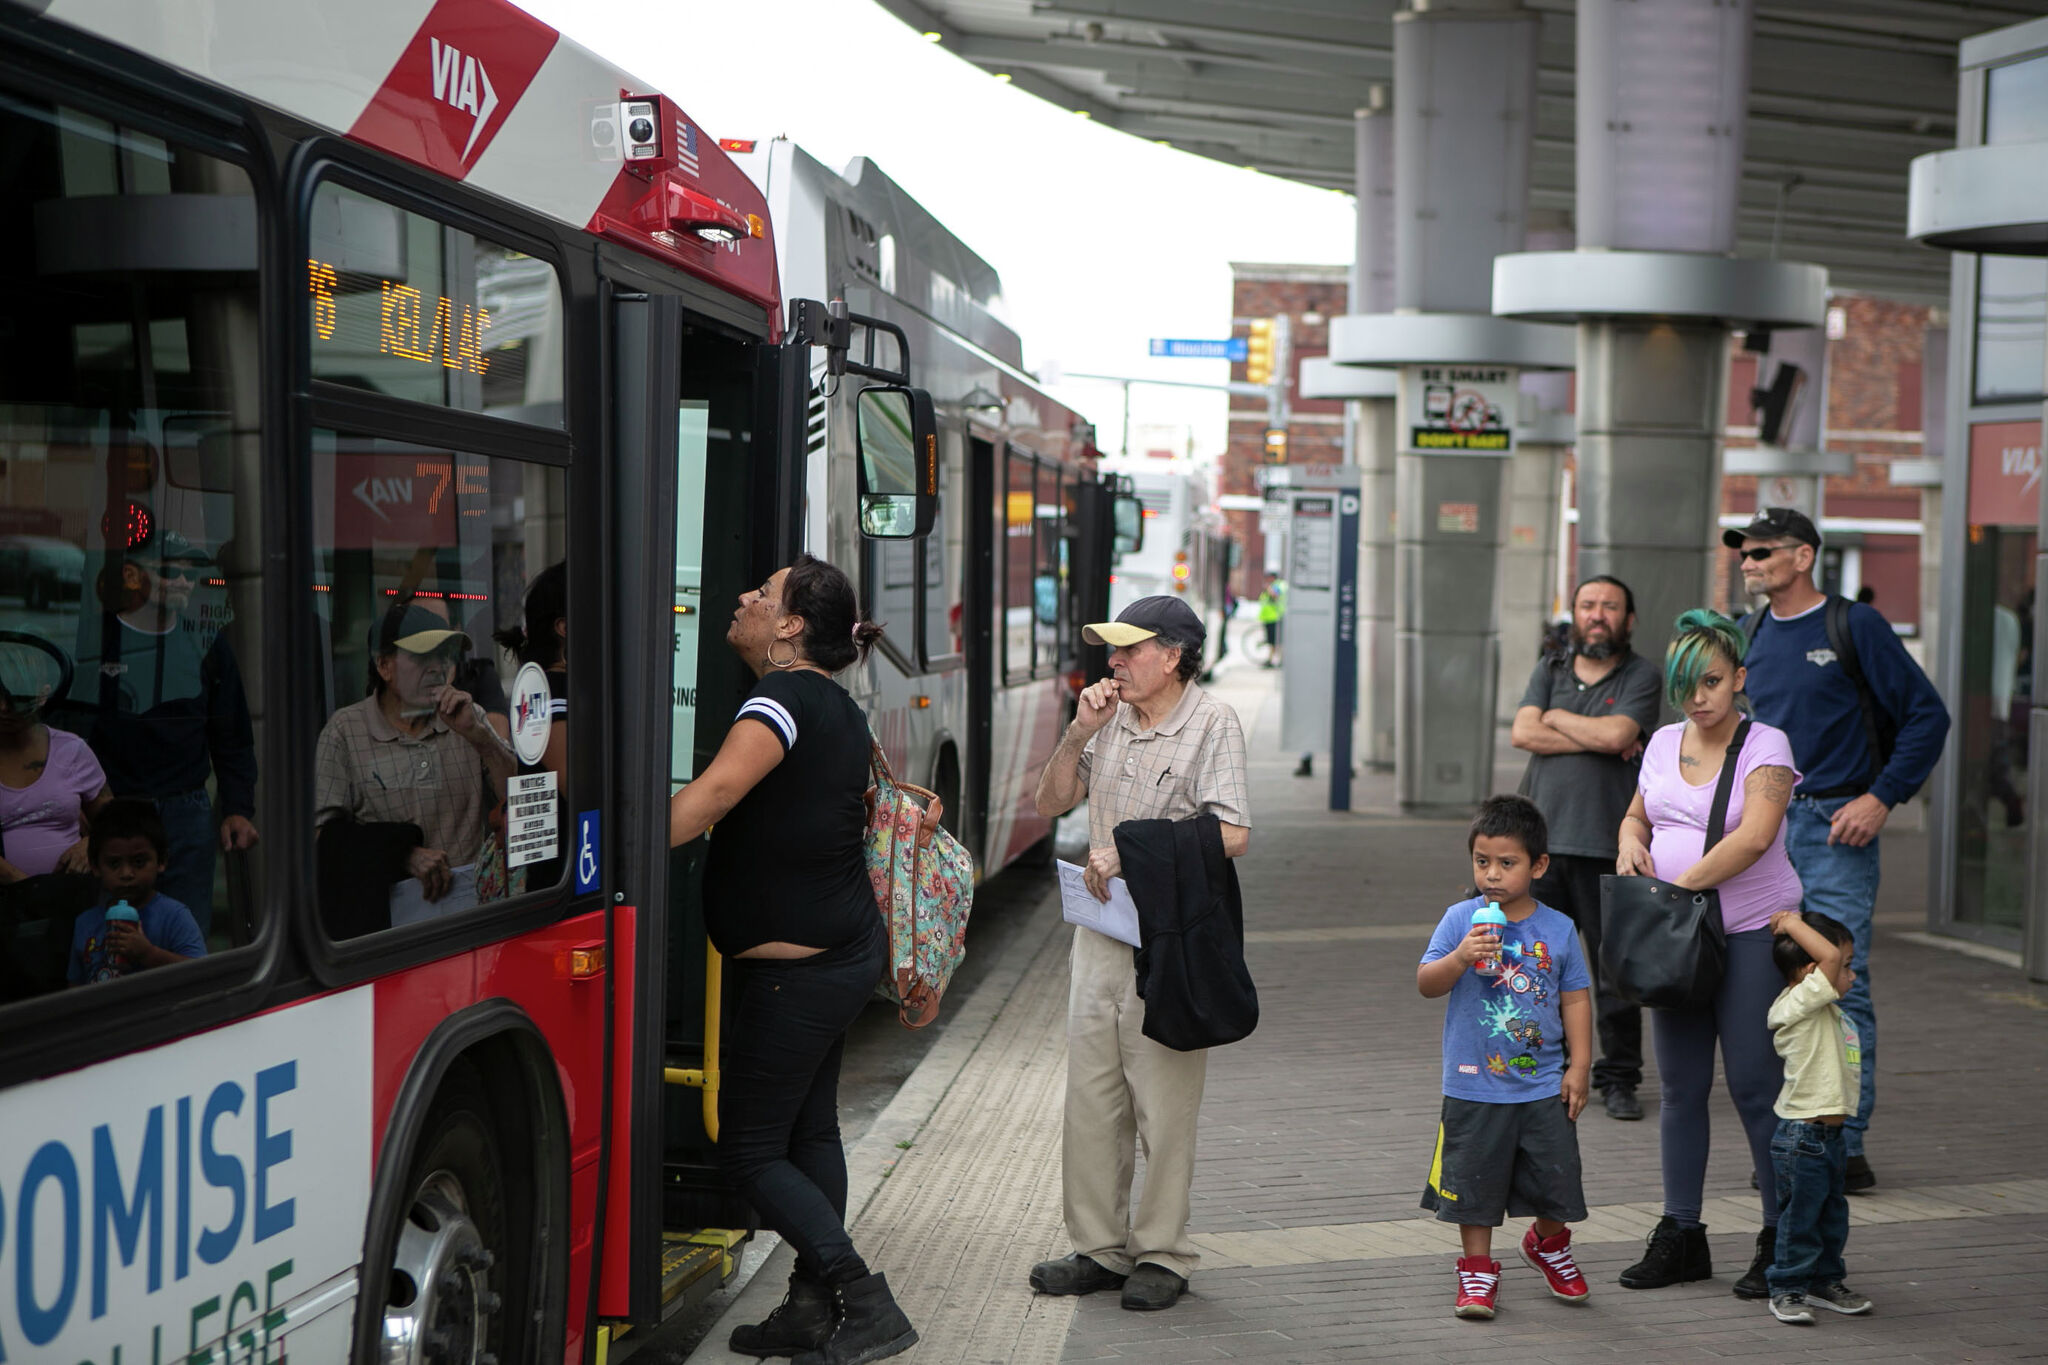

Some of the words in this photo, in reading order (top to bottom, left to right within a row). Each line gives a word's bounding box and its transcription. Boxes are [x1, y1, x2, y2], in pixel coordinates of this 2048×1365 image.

[430, 36, 479, 118] VIA
[1421, 368, 1441, 382] BE
[1448, 368, 1508, 384] SMART
[2002, 446, 2035, 476] VIA
[1341, 495, 1359, 515] D
[0, 1058, 298, 1363] OMISE
